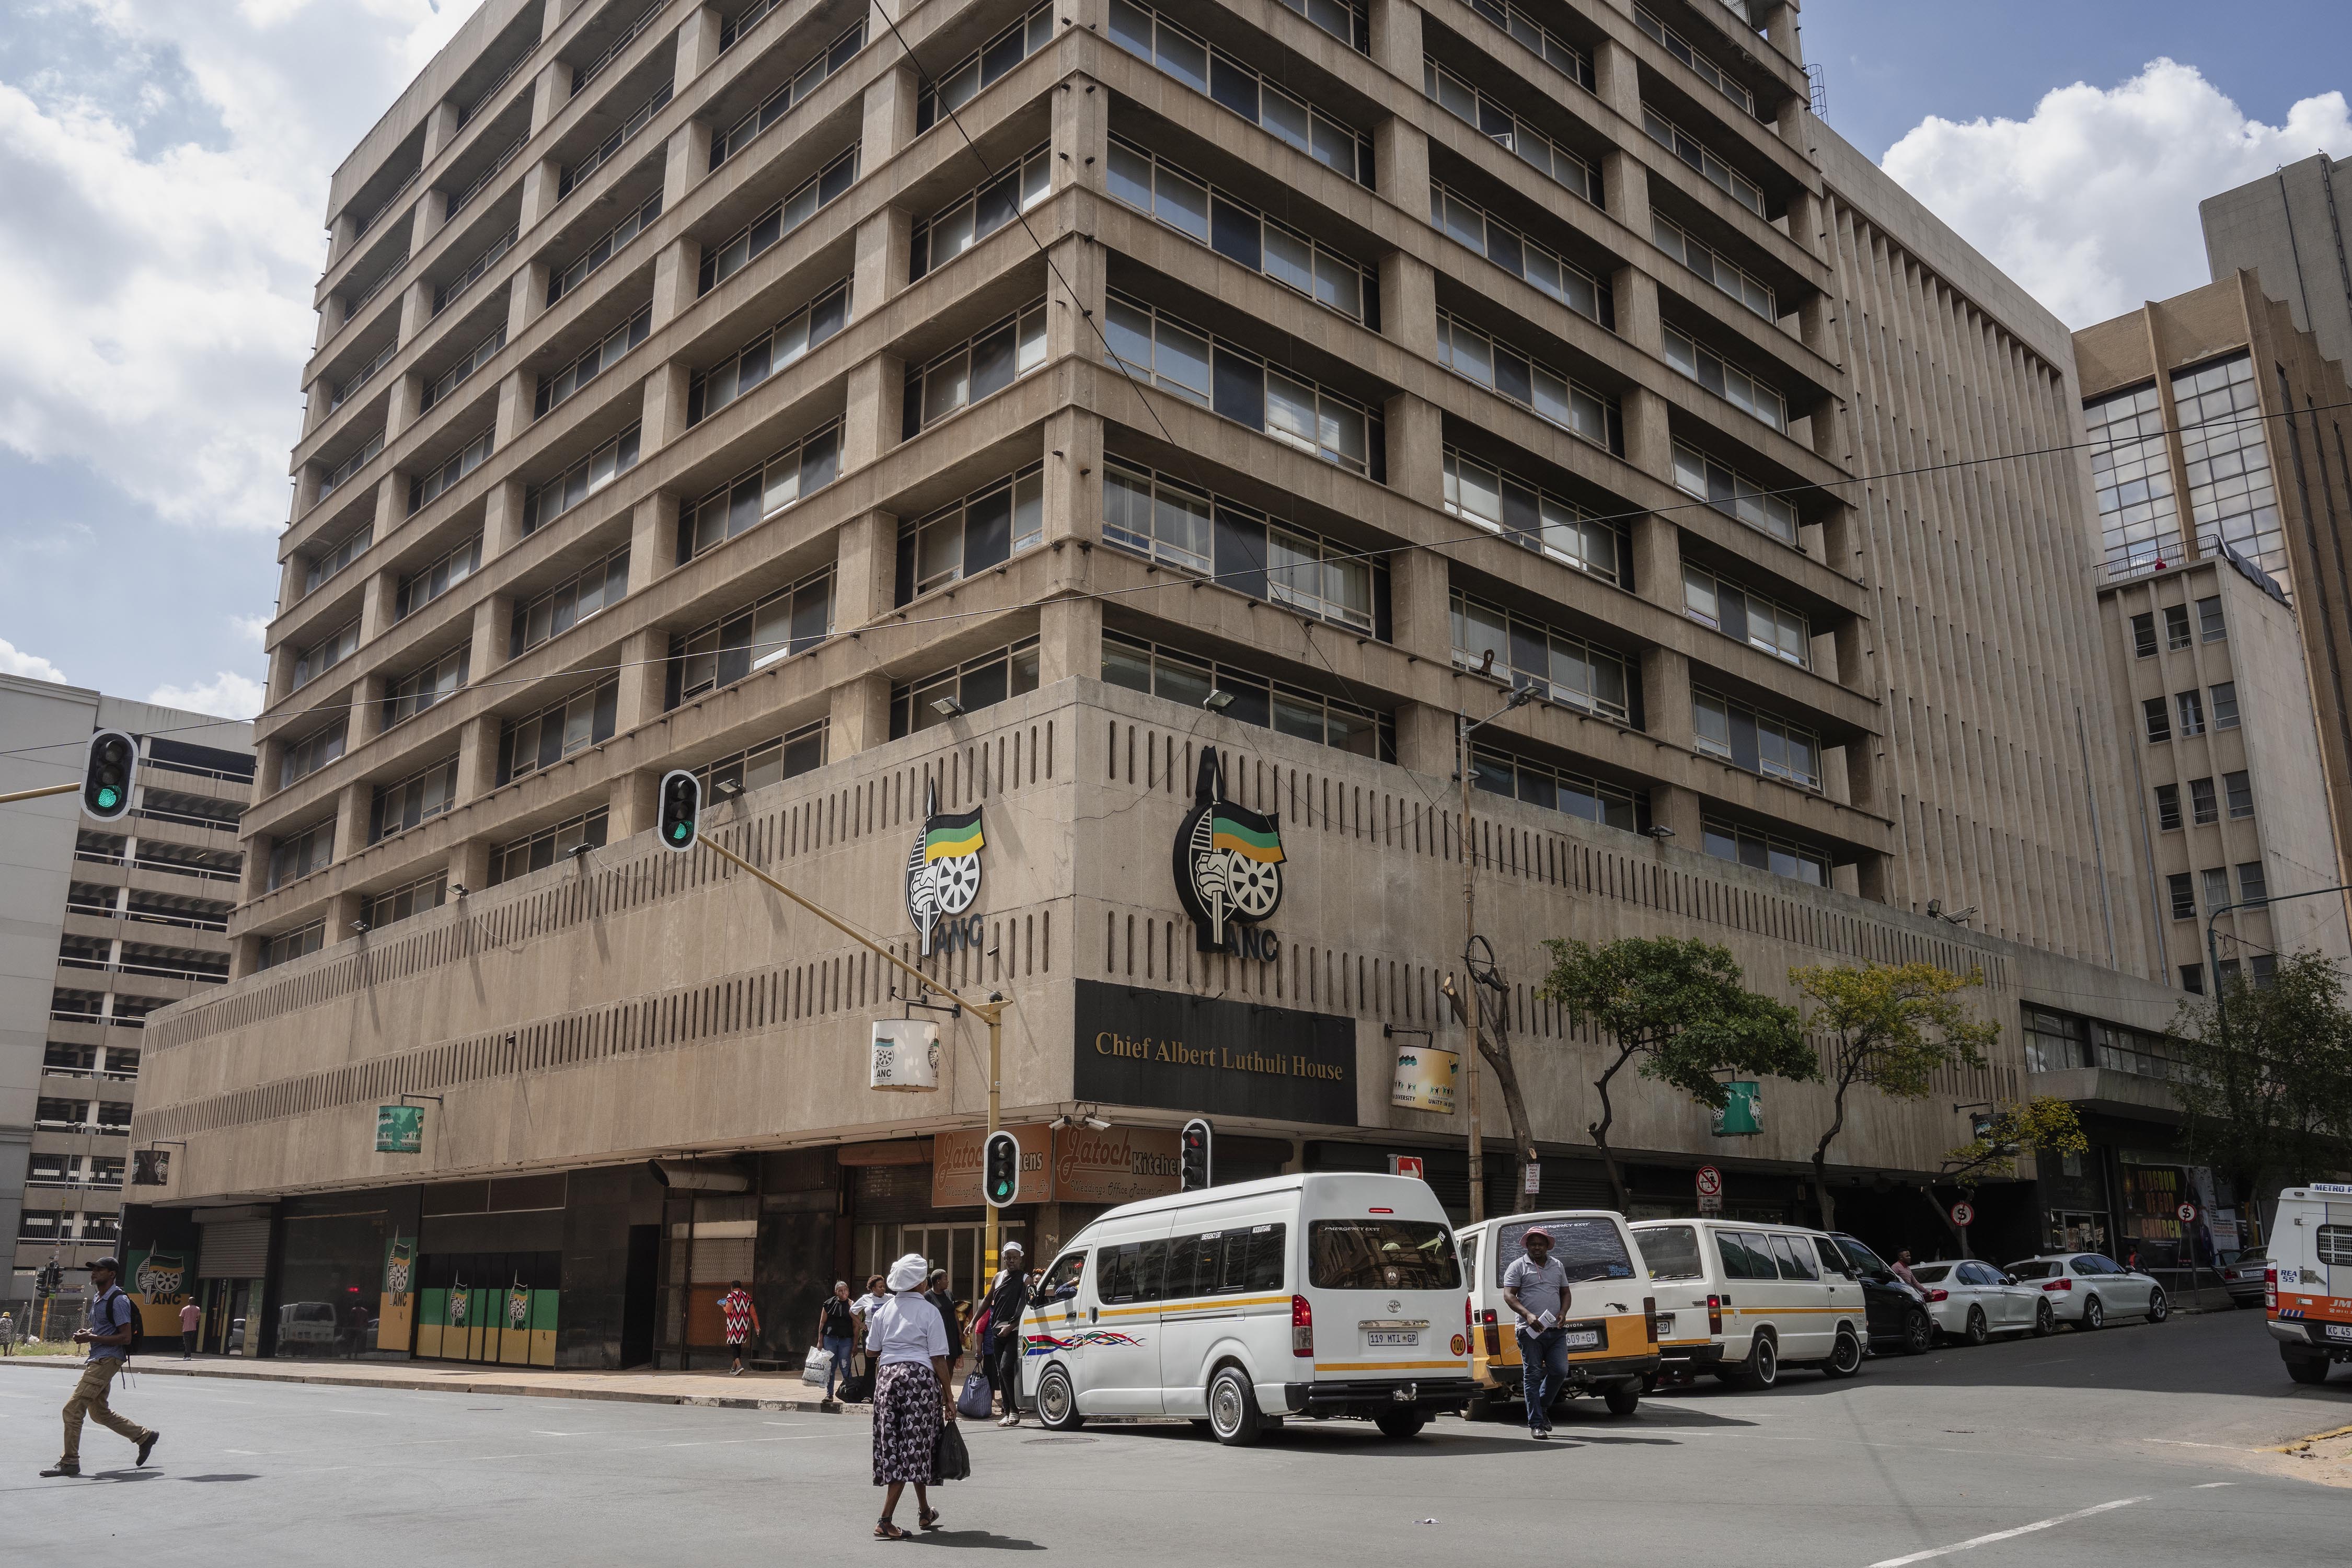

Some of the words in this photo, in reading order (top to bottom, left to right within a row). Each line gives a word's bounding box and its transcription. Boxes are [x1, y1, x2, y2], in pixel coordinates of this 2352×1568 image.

[934, 913, 984, 956] ANC
[1226, 924, 1277, 962] ANC
[1096, 1032, 1151, 1059] Chief
[1155, 1040, 1216, 1066] Albert
[1221, 1047, 1287, 1075] Luthuli
[1292, 1055, 1343, 1080] House
[877, 1069, 892, 1078] ANC
[1057, 1124, 1131, 1184] Jatoch
[1132, 1151, 1181, 1177] Kitche
[2138, 1171, 2177, 1191] KINGDOM
[972, 1183, 983, 1200] Offi
[2158, 1193, 2175, 1213] GOD
[2141, 1218, 2182, 1238] CHURCH
[152, 1294, 181, 1305] ANC
[393, 1293, 407, 1307] ANC
[455, 1318, 465, 1328] ANC
[514, 1320, 526, 1331] ANC
[1586, 1334, 1596, 1342] GP
[2328, 1326, 2337, 1335] KC
[2341, 1327, 2350, 1336] 45
[1370, 1334, 1383, 1343] 119
[1387, 1334, 1401, 1343] MTI
[1453, 1339, 1463, 1351] 100
